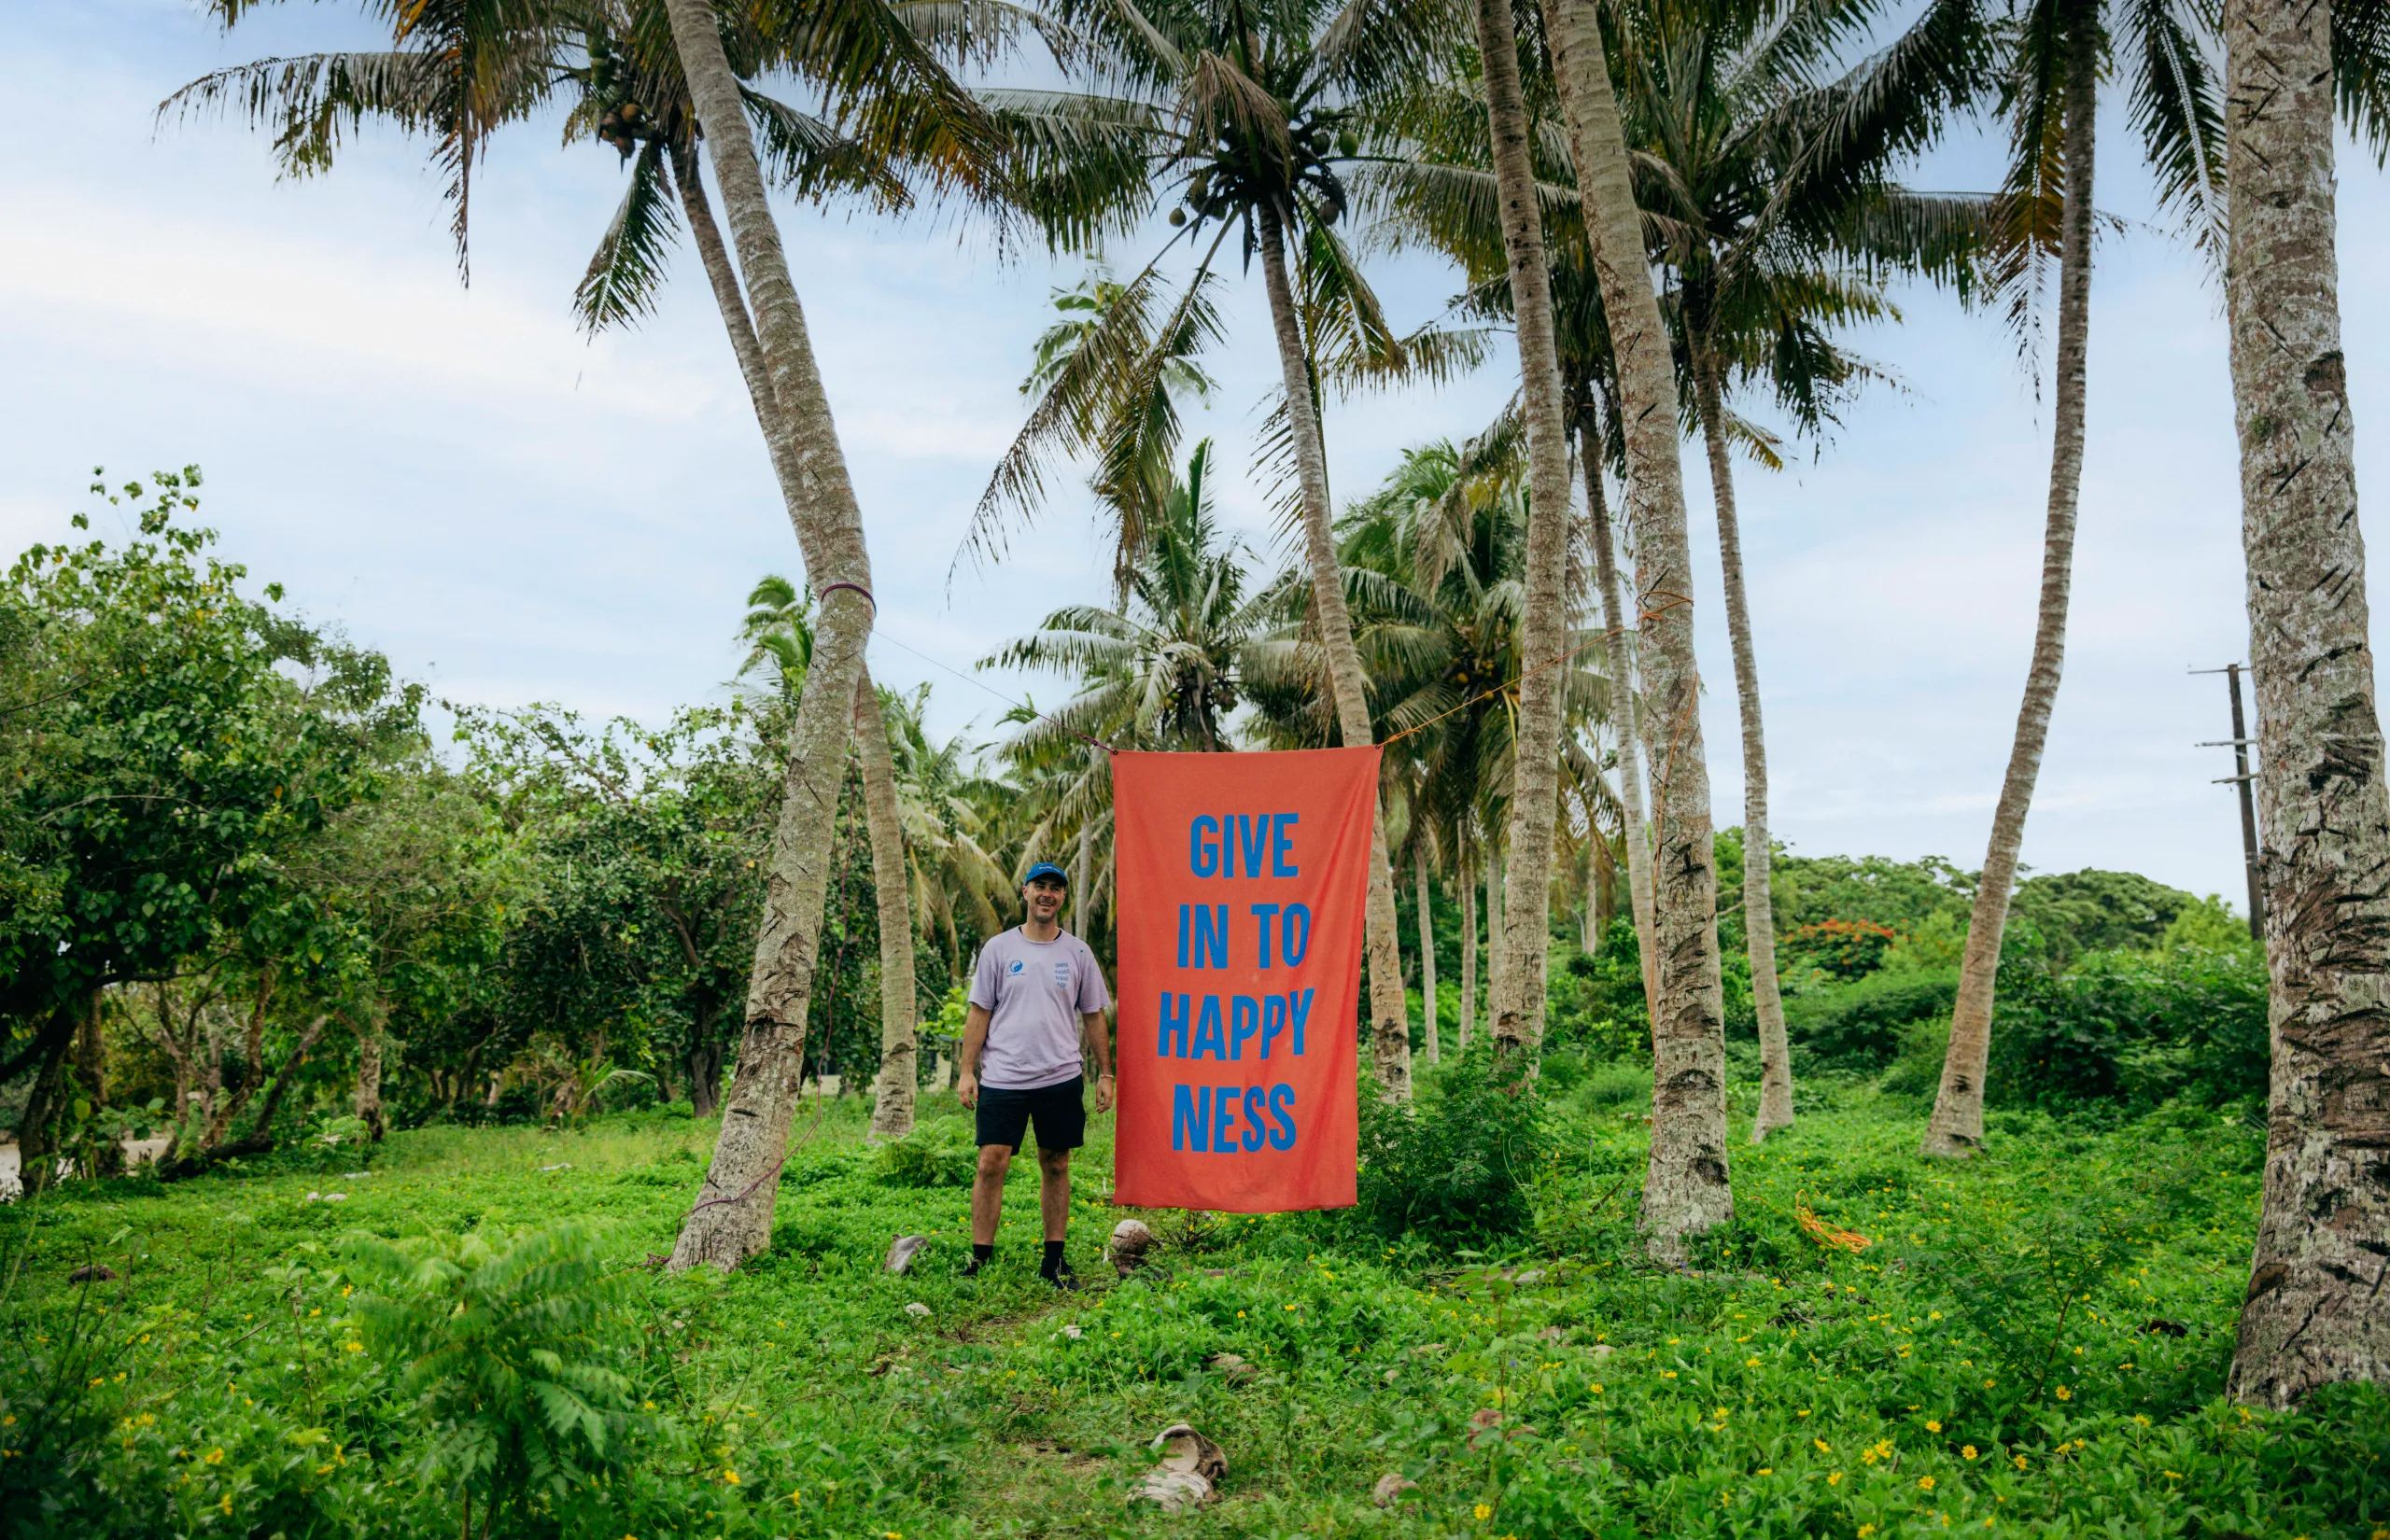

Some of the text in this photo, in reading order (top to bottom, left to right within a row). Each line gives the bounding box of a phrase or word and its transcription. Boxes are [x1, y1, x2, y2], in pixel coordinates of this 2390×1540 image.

[1190, 813, 1299, 878] GIVE
[1177, 903, 1311, 969] IN TO
[1158, 988, 1314, 1060] HAPPY
[1173, 1084, 1297, 1153] NESS
